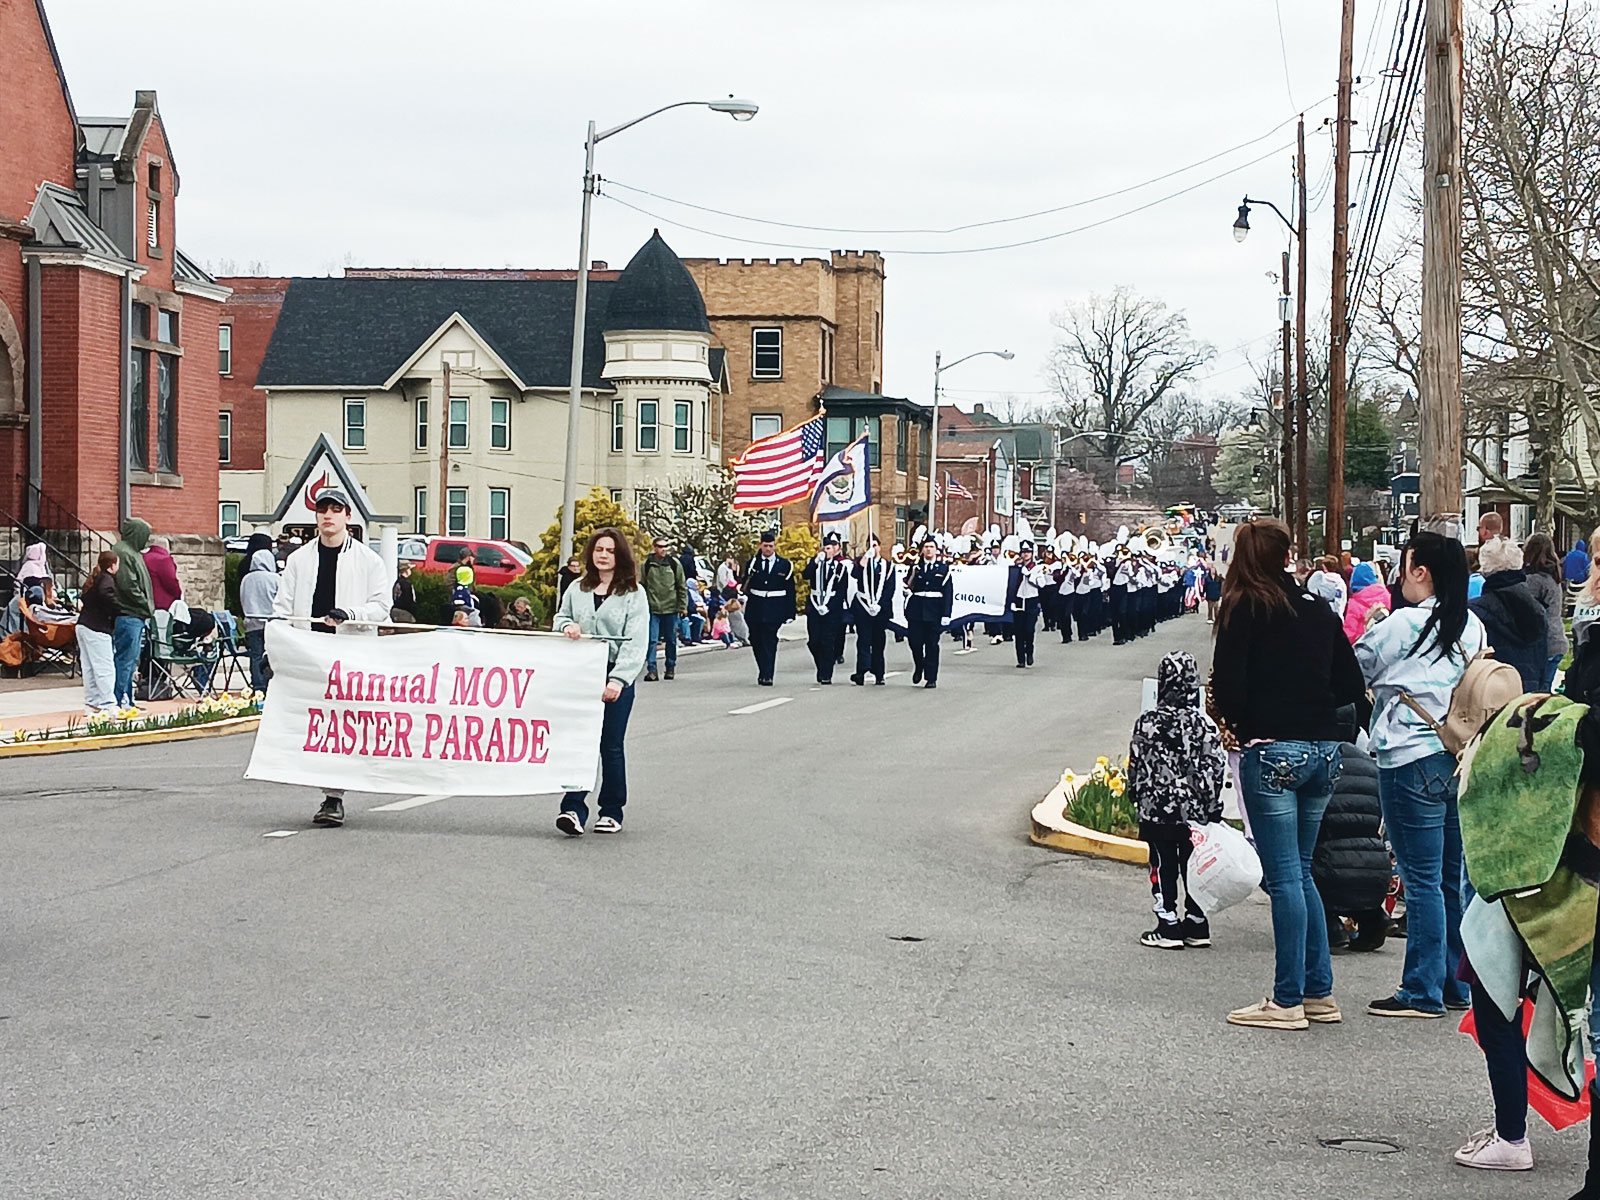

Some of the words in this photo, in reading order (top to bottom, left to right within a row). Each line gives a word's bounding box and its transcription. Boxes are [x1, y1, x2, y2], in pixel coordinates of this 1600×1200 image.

[954, 592, 986, 605] CHOOL
[324, 660, 440, 704] Annual
[449, 666, 535, 709] MOV
[303, 708, 413, 758] EASTER
[422, 713, 550, 764] PARADE
